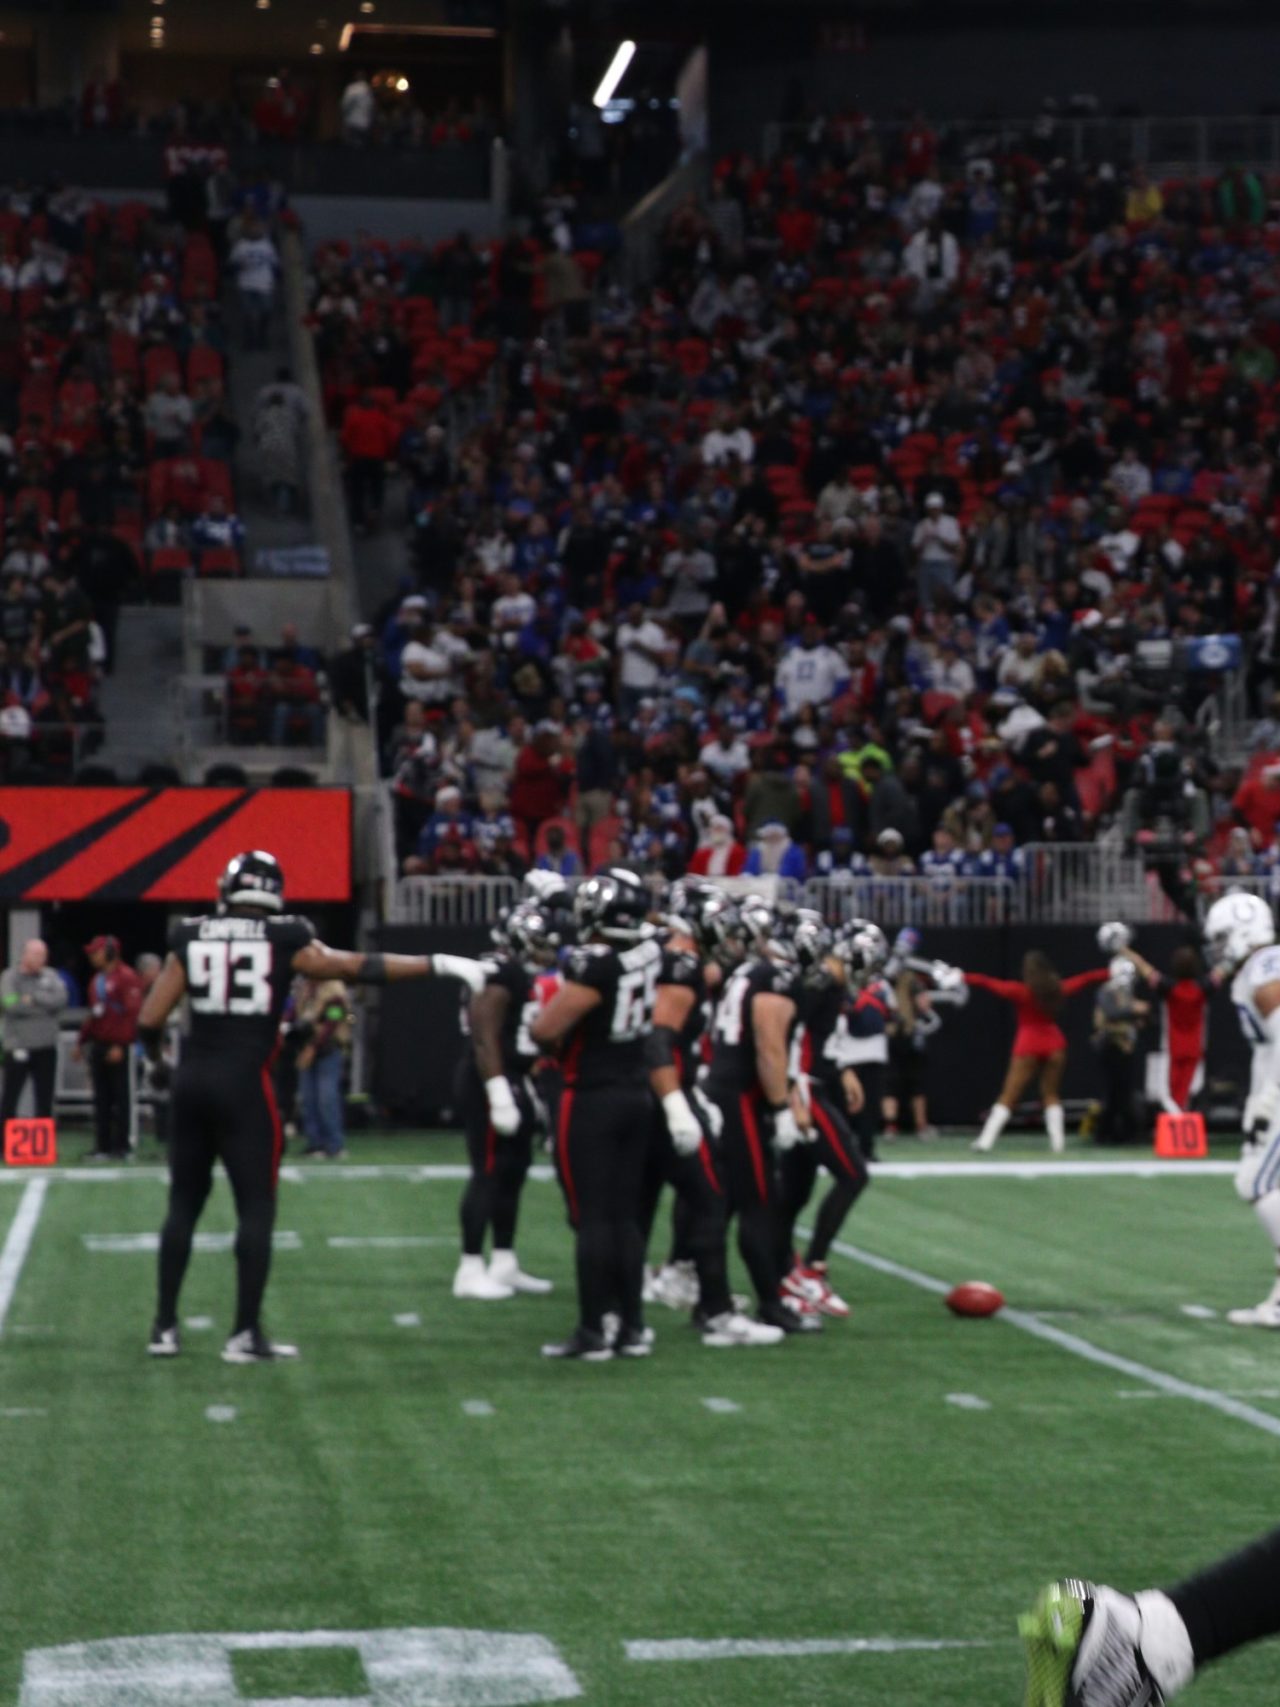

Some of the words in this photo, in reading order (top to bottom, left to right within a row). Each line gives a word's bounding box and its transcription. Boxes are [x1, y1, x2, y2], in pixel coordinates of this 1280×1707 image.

[187, 939, 272, 1014] 93
[11, 1125, 49, 1158] 20
[1168, 1118, 1200, 1150] 10
